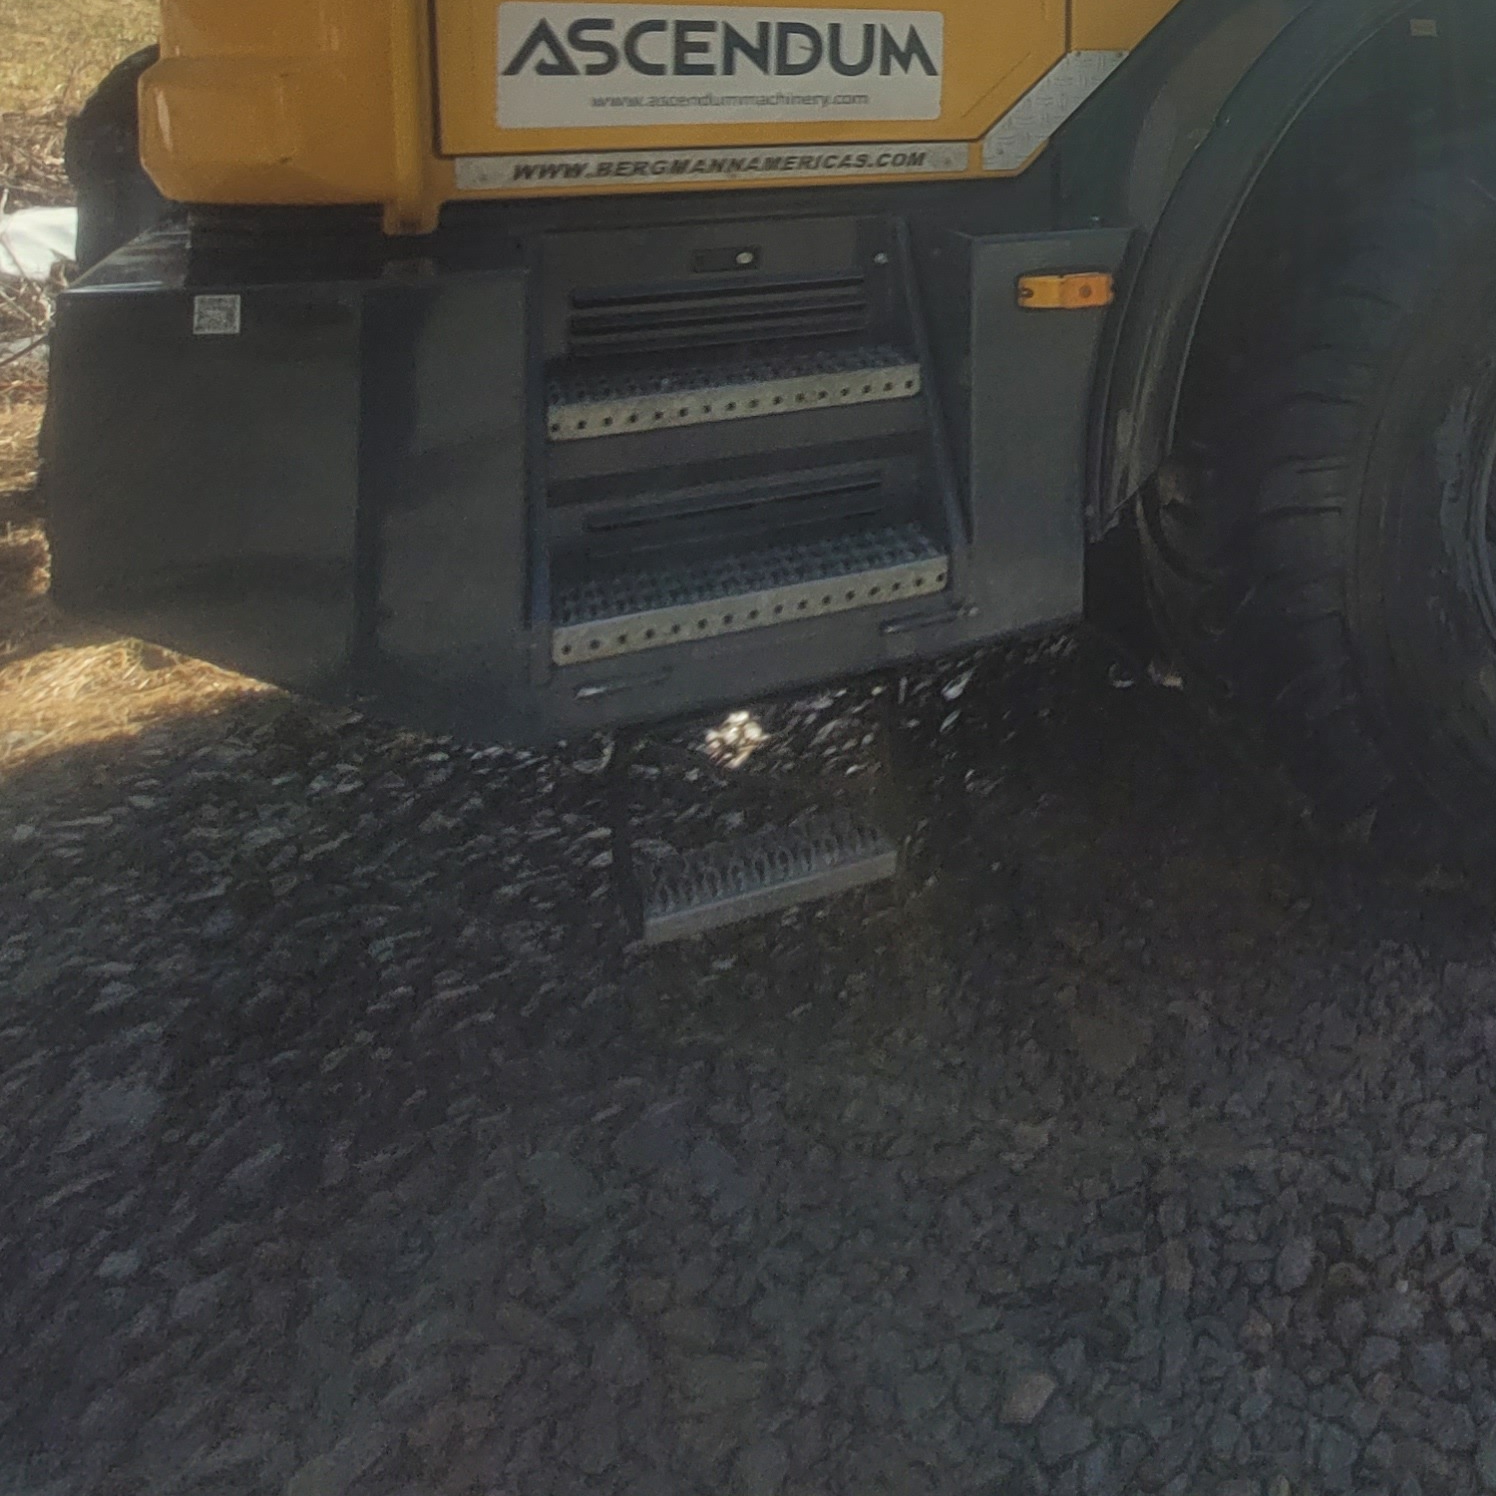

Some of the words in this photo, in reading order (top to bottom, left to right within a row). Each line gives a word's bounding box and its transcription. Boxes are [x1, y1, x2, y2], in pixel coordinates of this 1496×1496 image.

[501, 17, 938, 77] ASCENDUM
[591, 91, 869, 108] www.ascendummachinery.com
[511, 152, 926, 181] WWW.BERGMANNAMERICAS.COM
